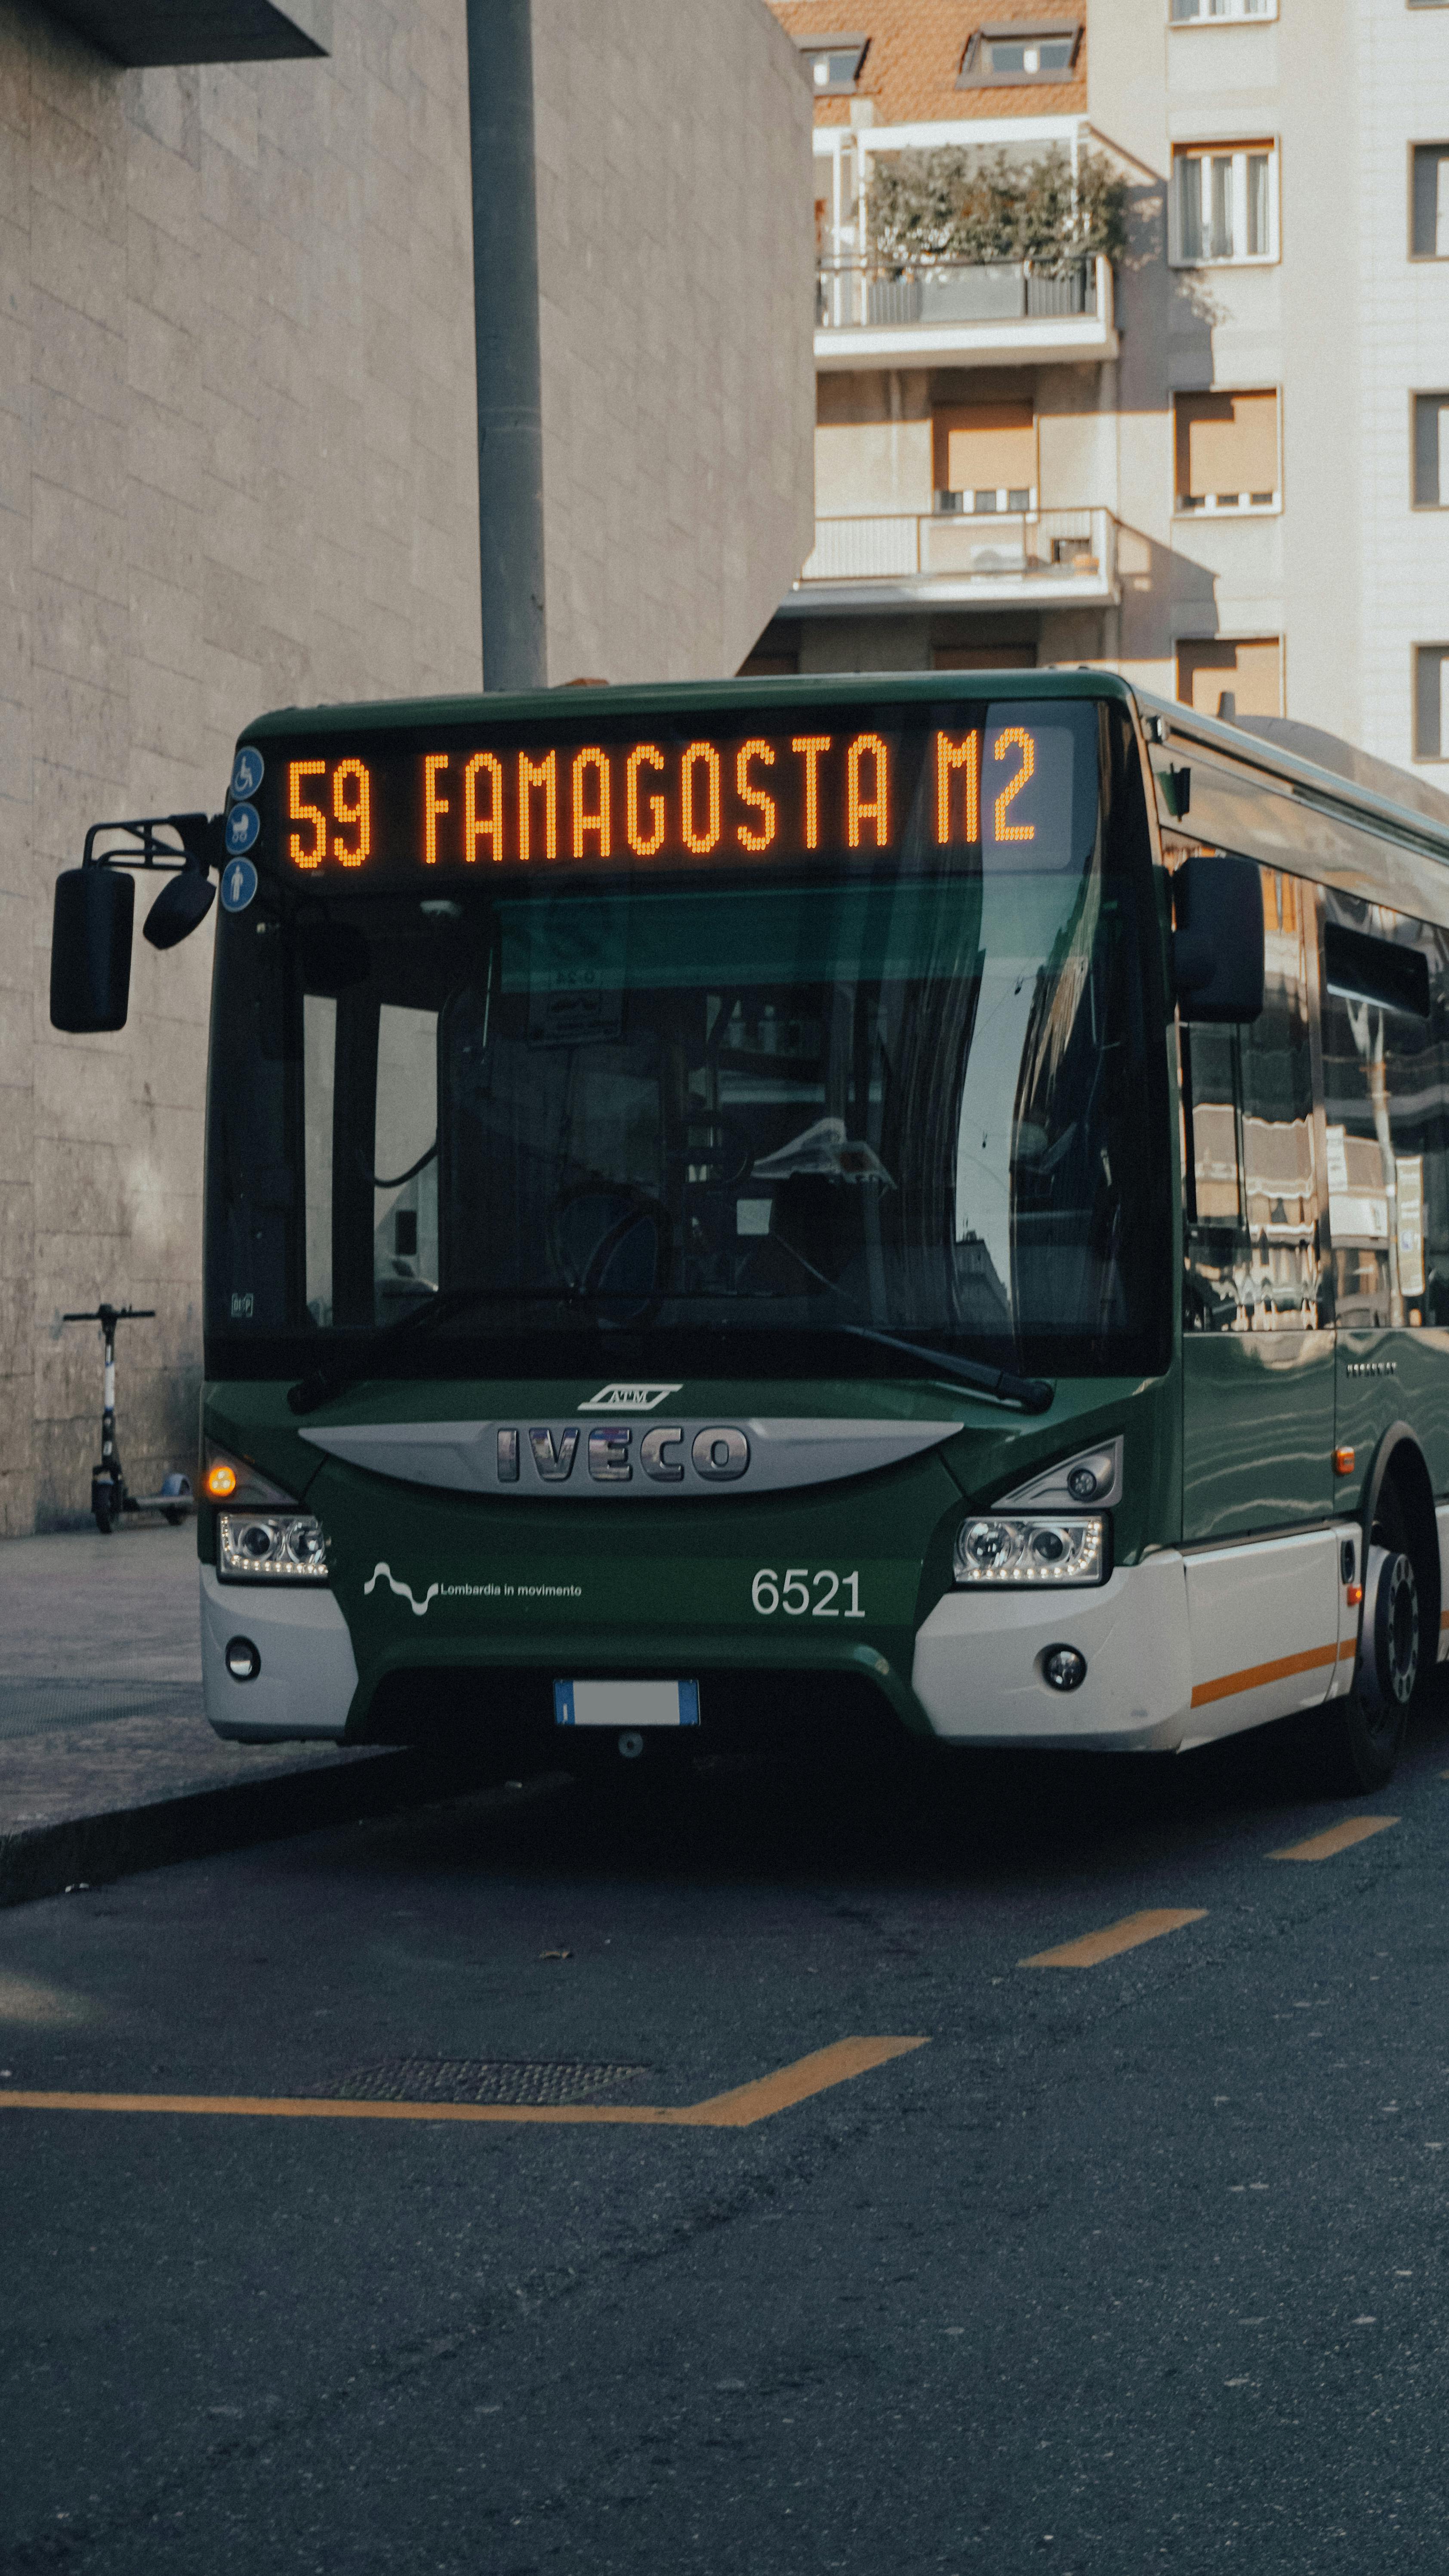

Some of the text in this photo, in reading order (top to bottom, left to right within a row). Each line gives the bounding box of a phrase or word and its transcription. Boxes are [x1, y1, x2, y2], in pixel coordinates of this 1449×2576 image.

[290, 727, 1035, 868] 59 FAMAGOSTA M2
[609, 1390, 648, 1404] ATM
[497, 1427, 750, 1482] IVECO
[441, 1583, 582, 1597] Lombardia in movimento
[752, 1568, 866, 1617] 6521
